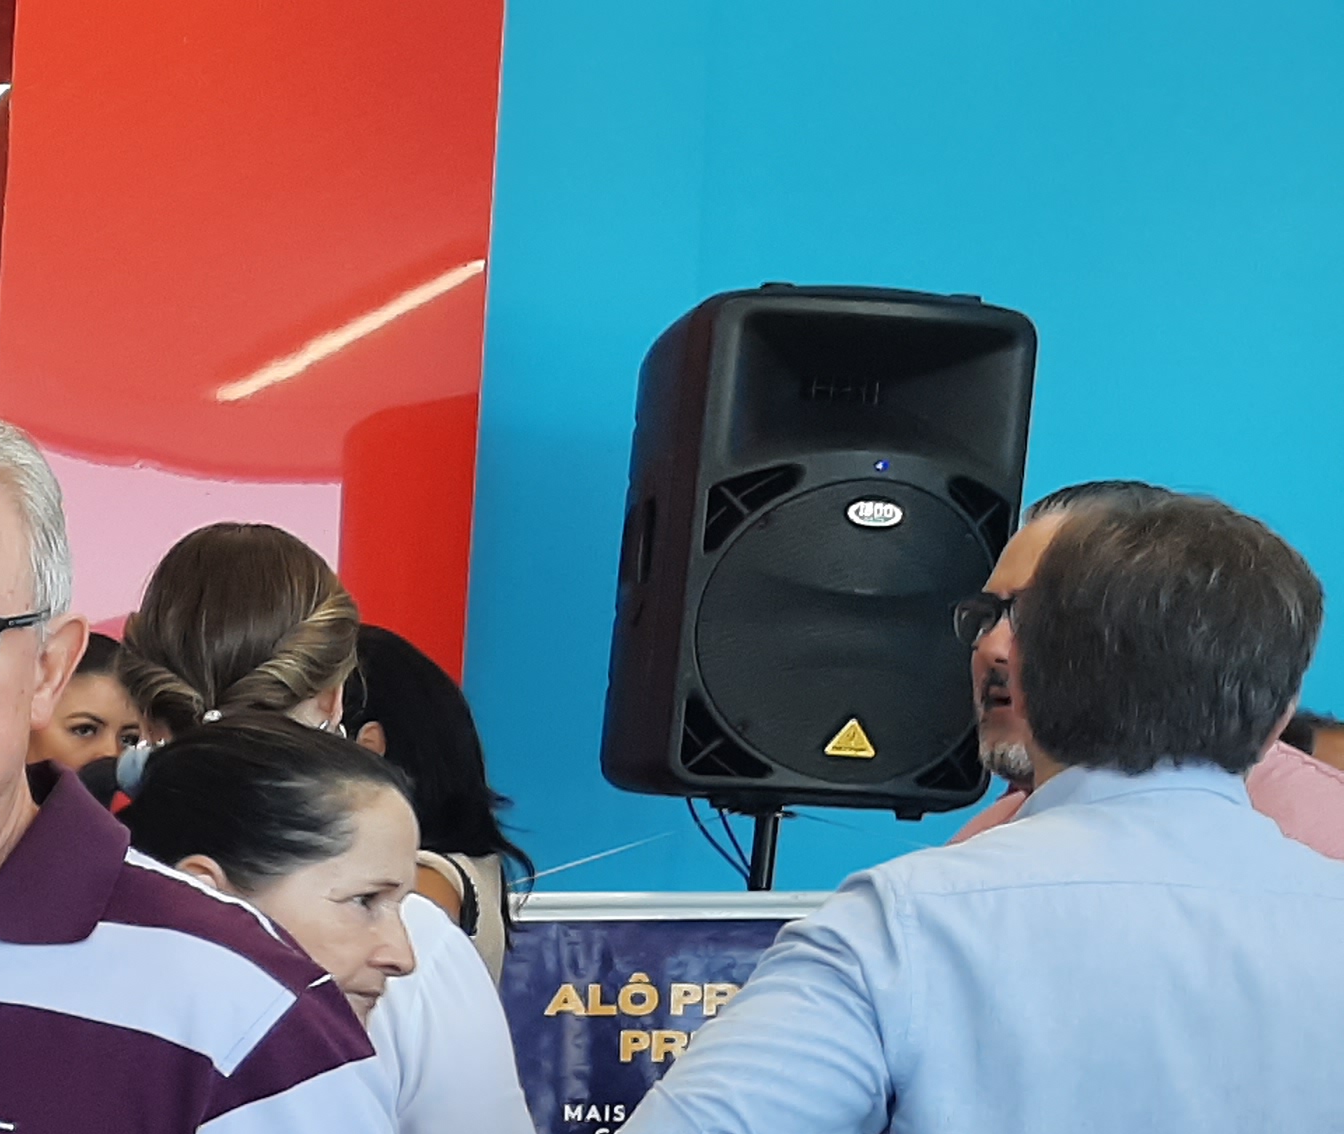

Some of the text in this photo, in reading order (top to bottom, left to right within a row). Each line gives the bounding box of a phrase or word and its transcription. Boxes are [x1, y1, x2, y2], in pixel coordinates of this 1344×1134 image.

[543, 972, 659, 1016] ALÔ
[619, 1030, 696, 1062] PR
[564, 1103, 625, 1122] MAIS
